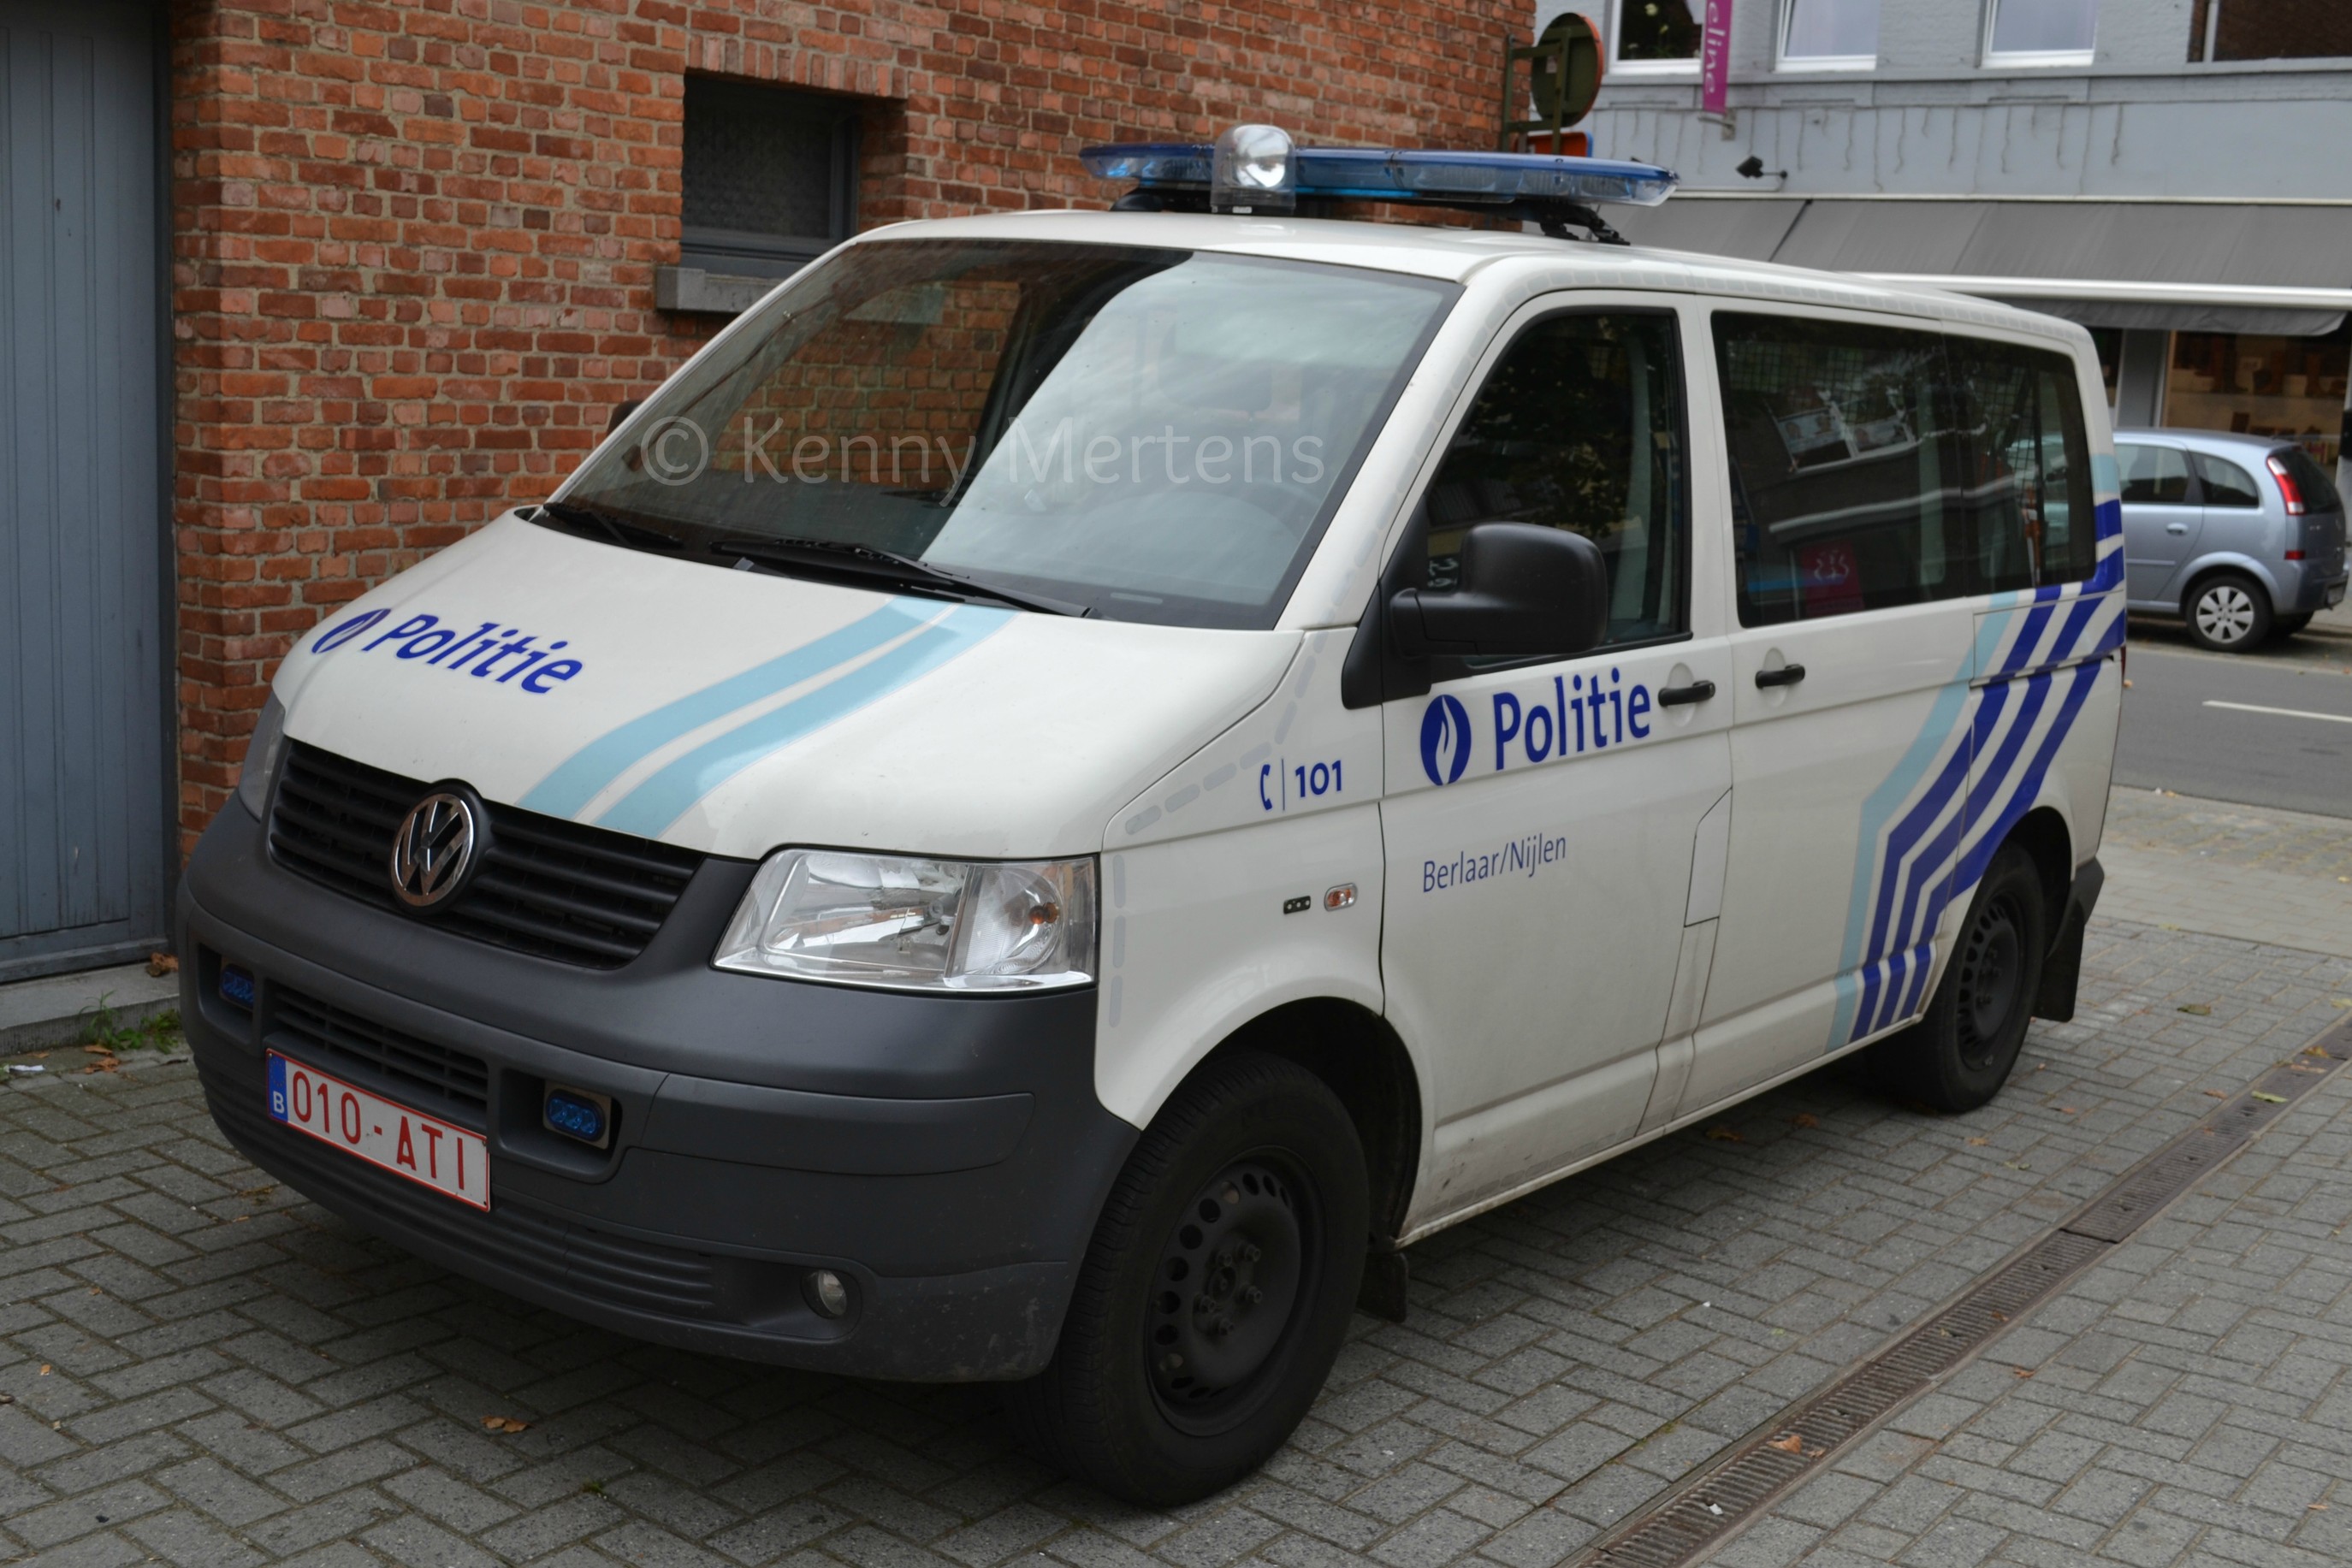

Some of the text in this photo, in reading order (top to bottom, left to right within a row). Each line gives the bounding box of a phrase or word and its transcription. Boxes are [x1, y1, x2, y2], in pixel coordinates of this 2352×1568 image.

[360, 614, 583, 694] Politie
[1492, 667, 1650, 771] Politie
[1295, 760, 1342, 798] 101
[1423, 832, 1567, 892] Berlaar/Nijlen
[293, 1071, 465, 1190] 010-ATI
